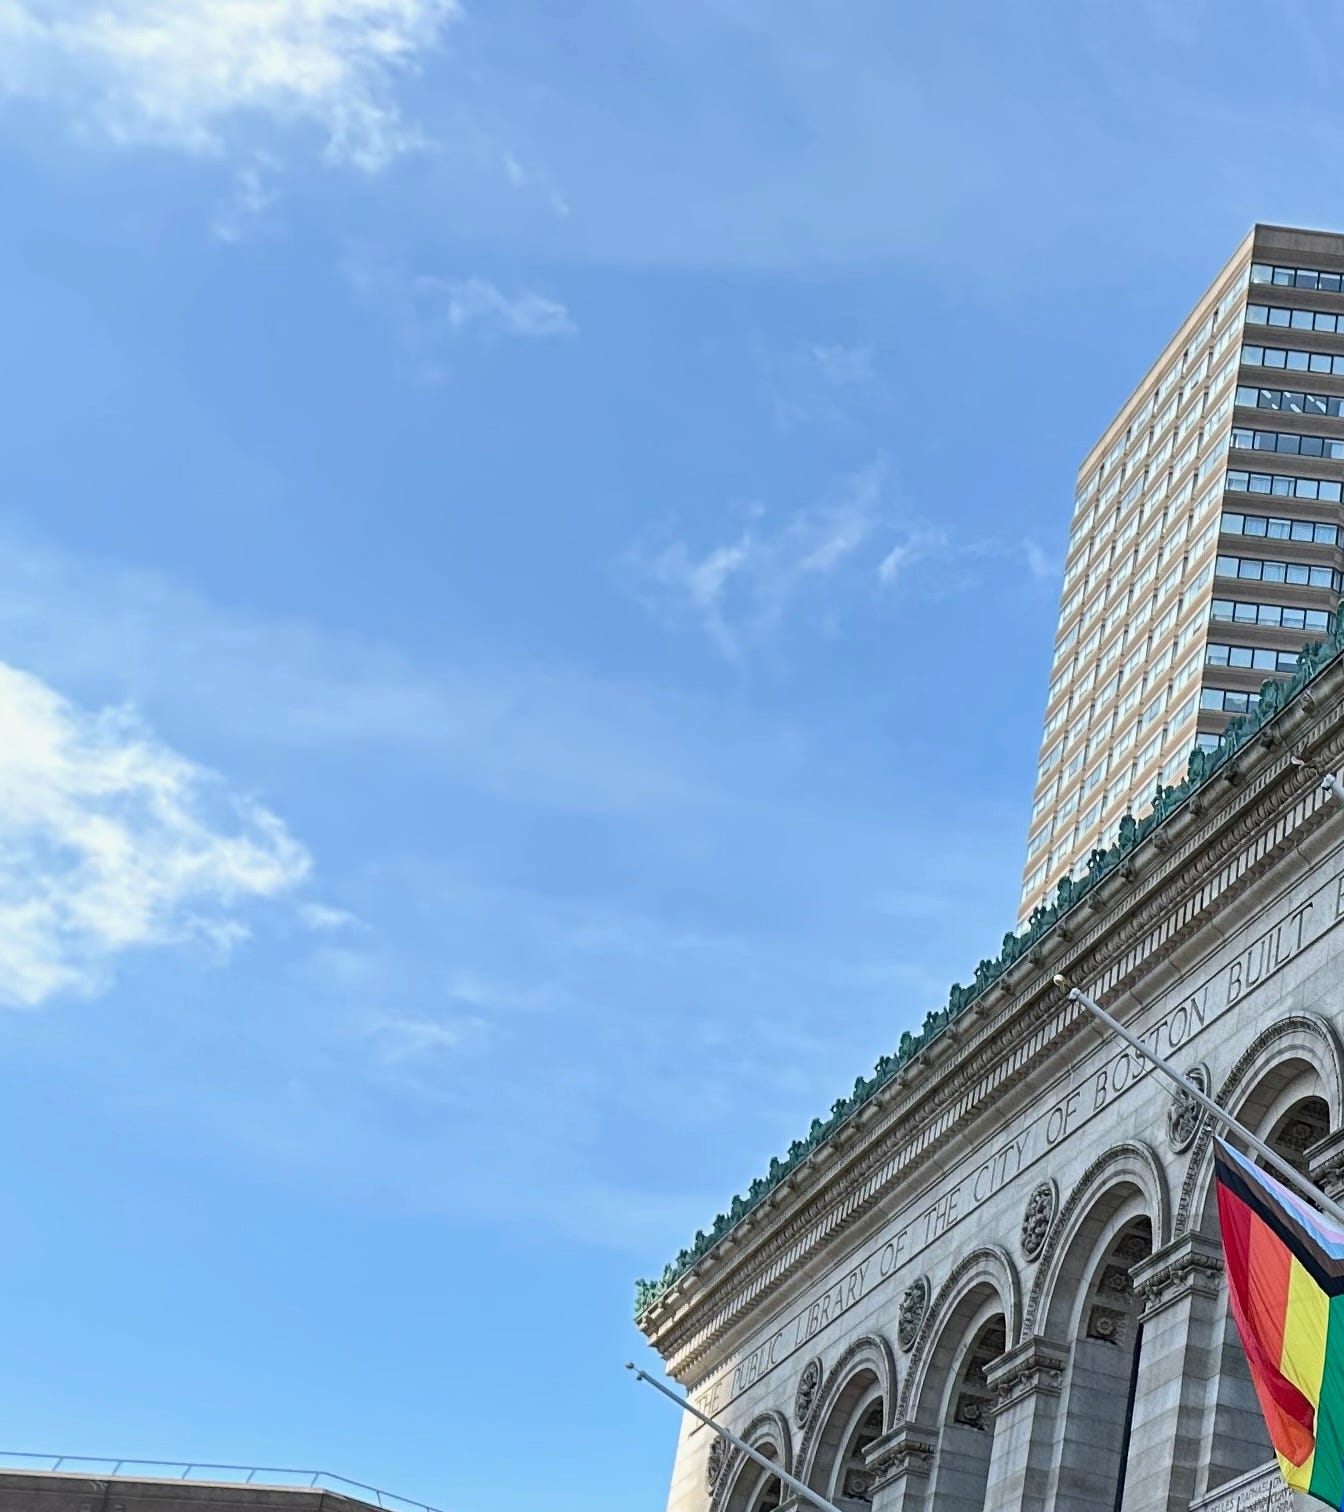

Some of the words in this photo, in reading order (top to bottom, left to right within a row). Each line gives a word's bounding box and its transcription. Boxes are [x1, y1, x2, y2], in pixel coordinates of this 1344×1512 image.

[695, 1381, 724, 1425] THE
[730, 1332, 782, 1399] PUBLIC
[794, 1260, 871, 1348] LIBRARY
[880, 1231, 907, 1276] OF
[923, 1188, 961, 1244] THE
[974, 1131, 1030, 1202] CITY
[1046, 1091, 1080, 1145] OF
[1093, 987, 1208, 1112] BOSTON
[1225, 902, 1313, 1006] BUILT
